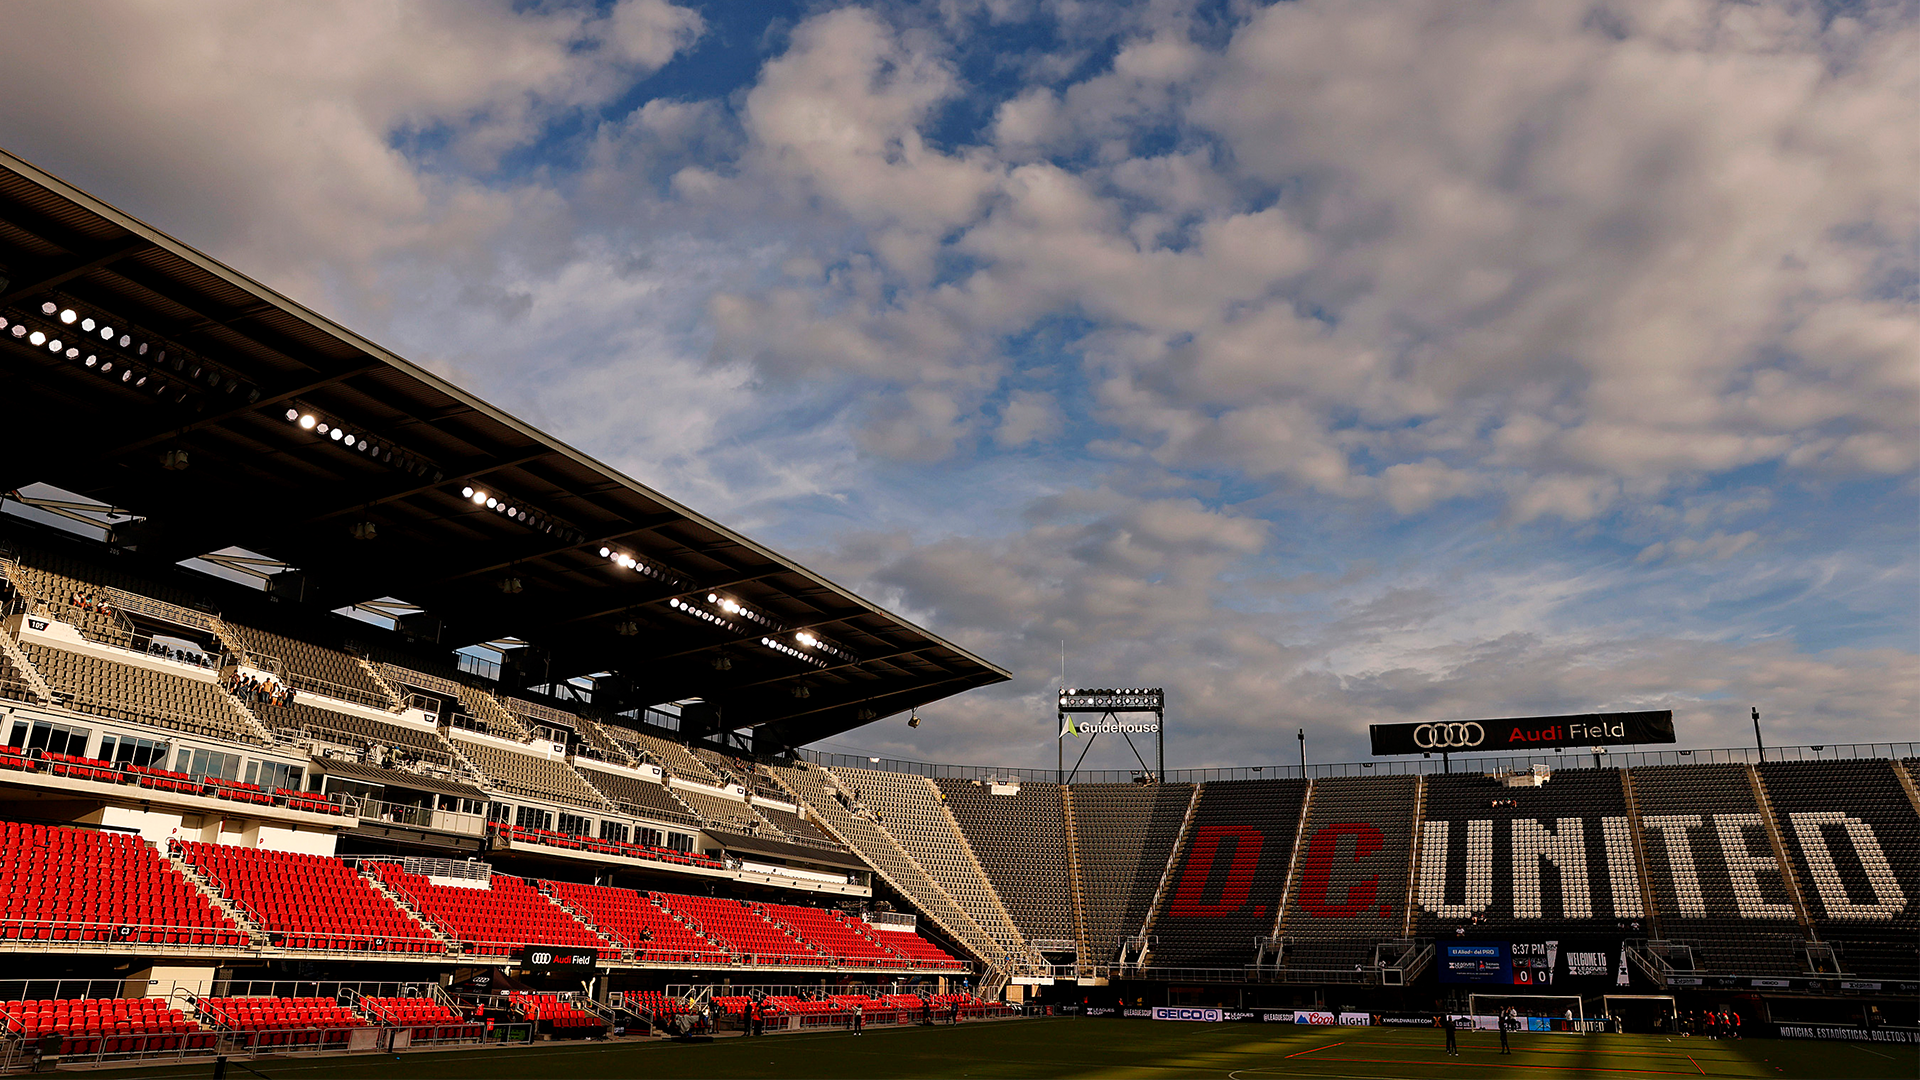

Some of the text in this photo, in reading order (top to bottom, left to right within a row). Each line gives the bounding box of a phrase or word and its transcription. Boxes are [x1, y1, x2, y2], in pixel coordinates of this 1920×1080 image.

[32, 621, 45, 629] 105
[1079, 722, 1159, 733] Guidehouse
[1508, 722, 1624, 742] Audi Field
[1418, 812, 1908, 920] UNITED
[121, 927, 130, 935] C3
[1512, 944, 1546, 954] 6:37 PM
[553, 955, 591, 965] Audi Field
[1566, 952, 1597, 966] WELCOME
[1520, 971, 1546, 982] 0 0
[1123, 1008, 1152, 1017] @LEAGUESCUP
[1157, 1009, 1203, 1019] GEICO
[1263, 1013, 1294, 1022] @LEAGUESCUP
[1308, 1012, 1368, 1025] Coor LIGHT
[1872, 1030, 1906, 1042] BOLETOS
[1906, 1031, 1912, 1043] Y
